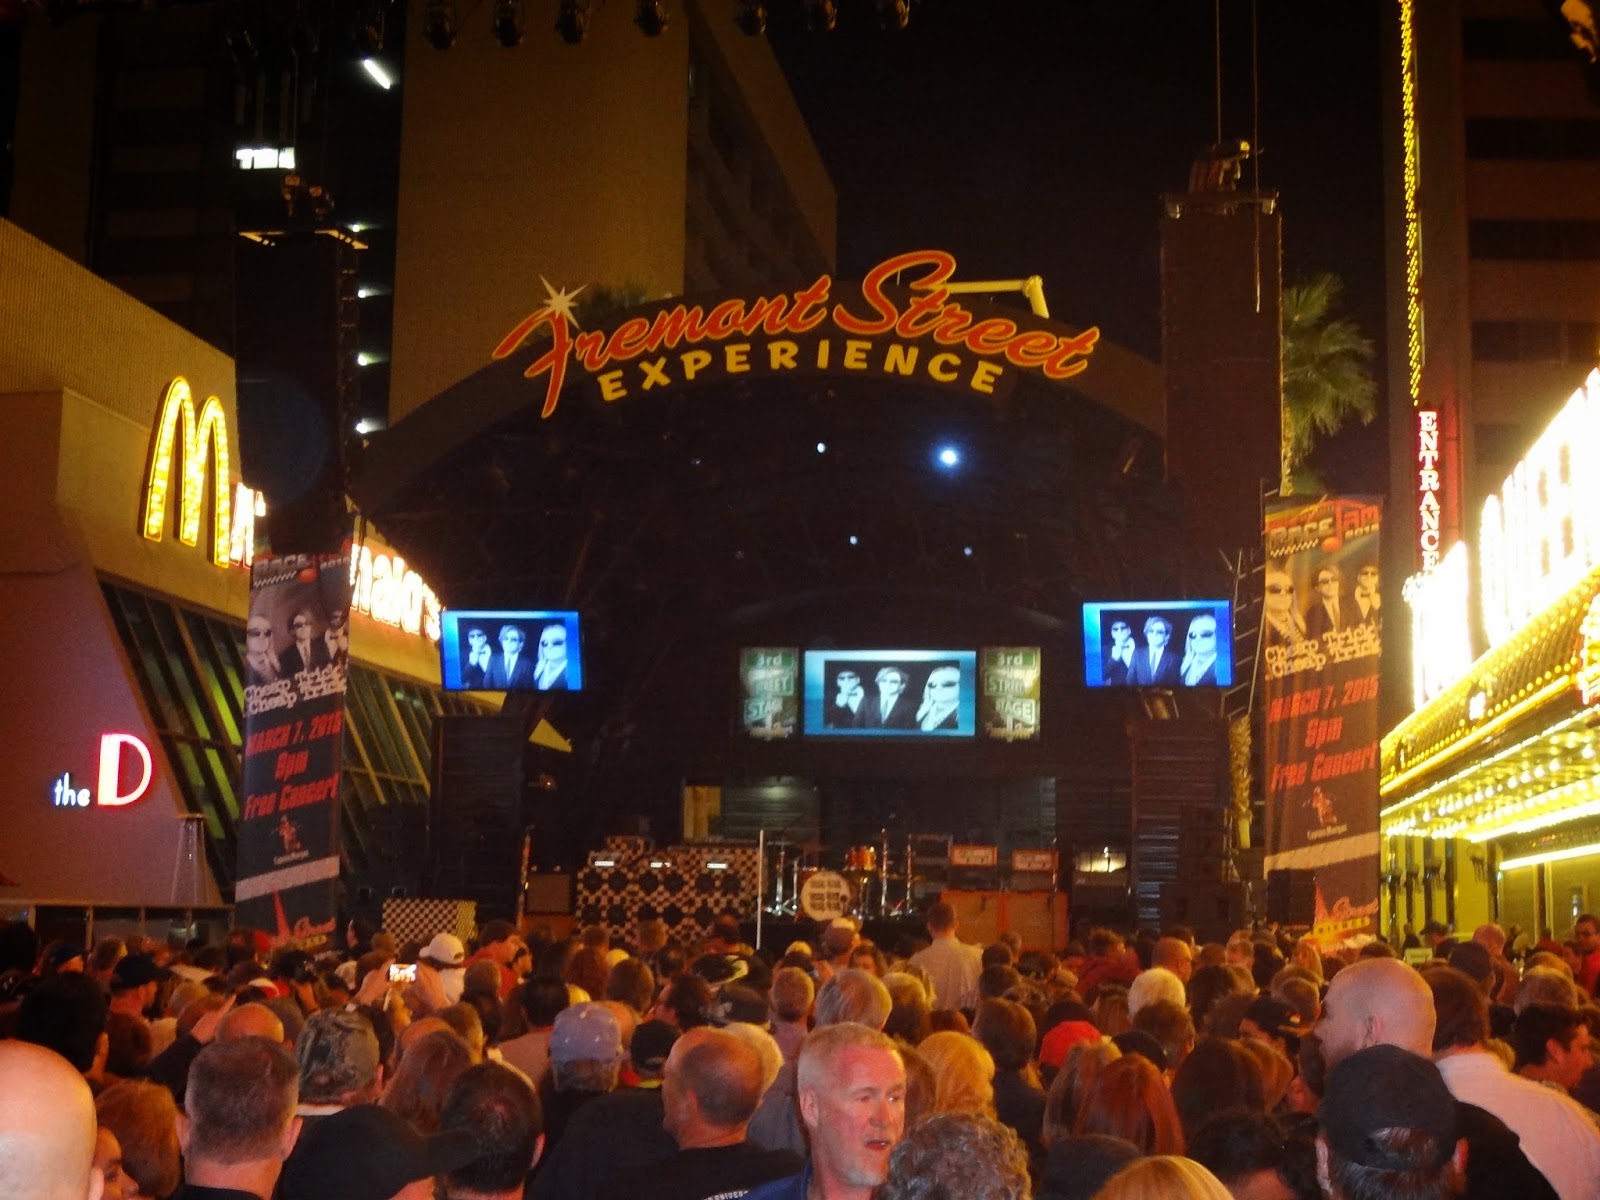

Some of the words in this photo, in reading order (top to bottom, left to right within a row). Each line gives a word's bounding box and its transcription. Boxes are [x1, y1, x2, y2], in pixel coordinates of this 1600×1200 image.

[492, 275, 830, 418] Fremont
[833, 249, 1100, 379] Street
[596, 338, 1004, 402] EXPERIENCE
[1418, 410, 1441, 572] ENTRANCE
[997, 652, 1023, 666] 3rd
[1272, 651, 1327, 678] Cheap
[1269, 689, 1321, 722] MARCH
[1342, 676, 1379, 705] 2015
[247, 726, 291, 756] MARCH
[54, 772, 91, 807] the
[96, 732, 152, 806] D
[1270, 761, 1308, 793] Free
[1311, 742, 1377, 782] Concert
[244, 792, 277, 821] Free
[280, 773, 339, 810] Concert
